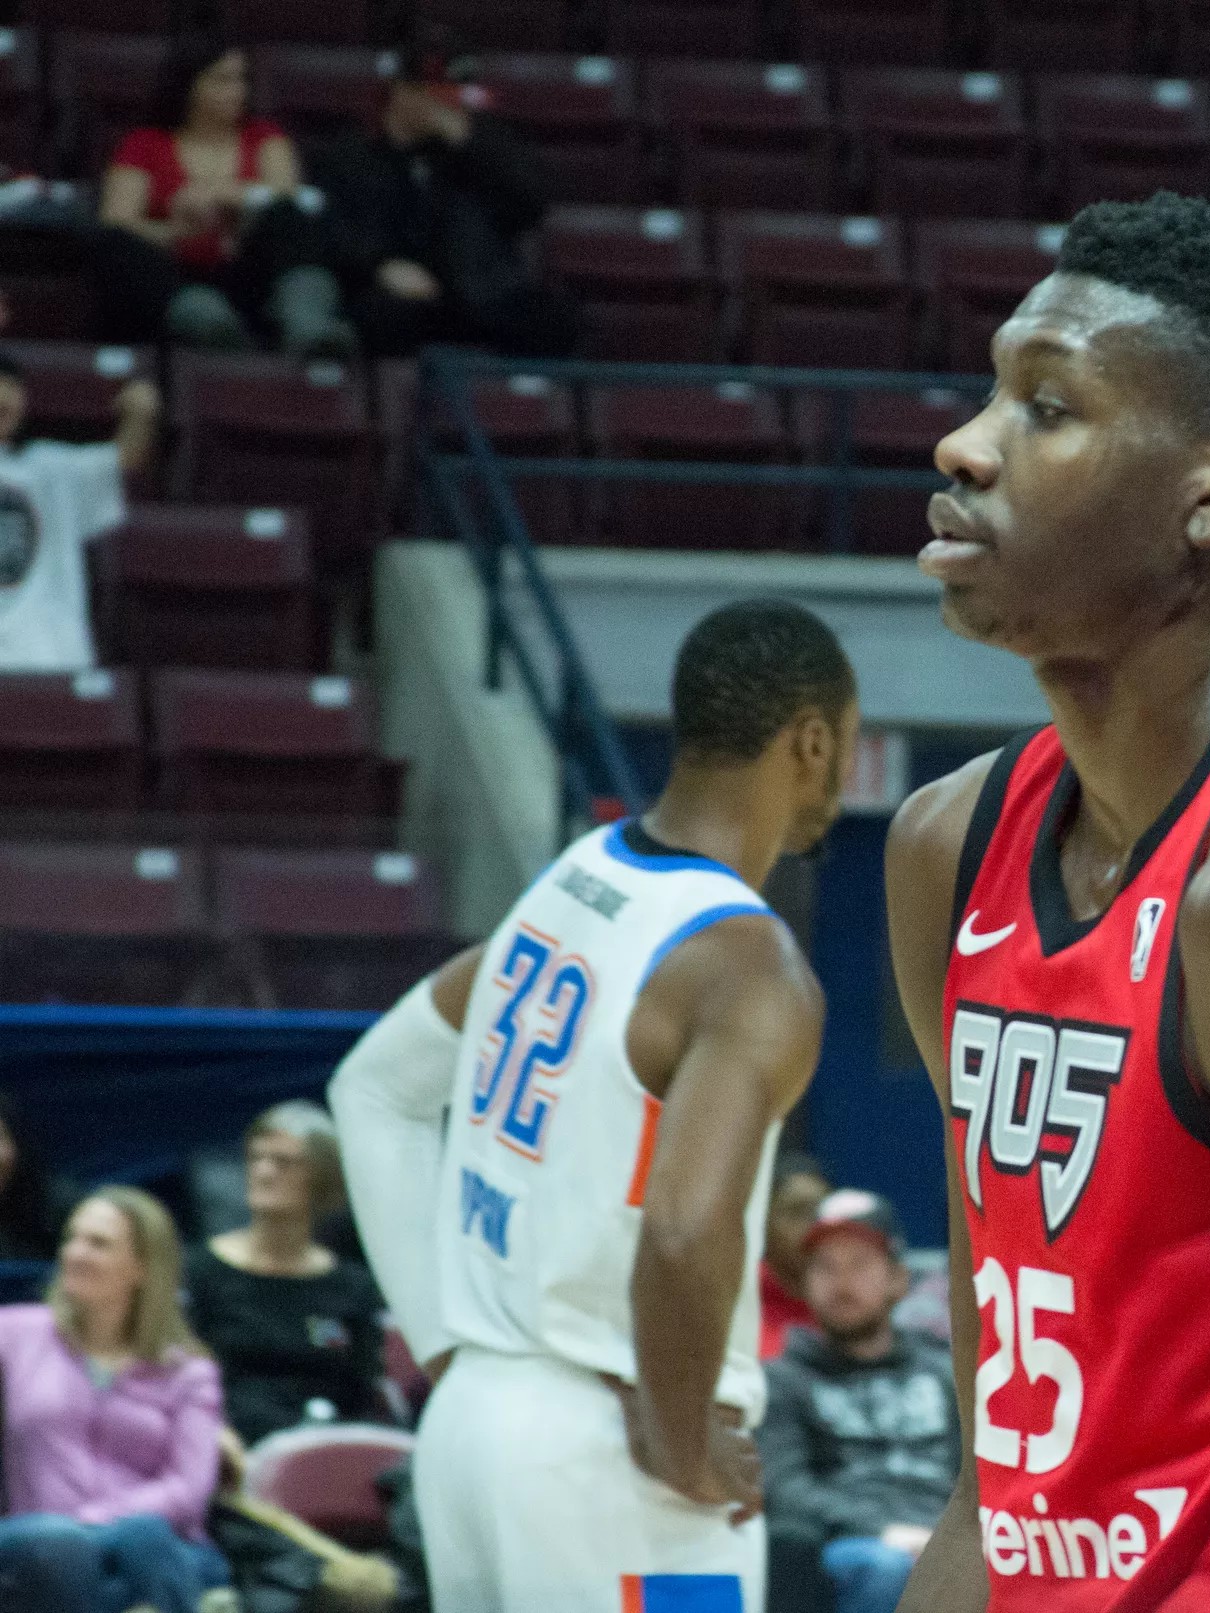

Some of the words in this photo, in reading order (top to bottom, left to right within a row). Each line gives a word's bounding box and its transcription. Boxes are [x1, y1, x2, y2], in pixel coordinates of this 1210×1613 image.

[469, 922, 595, 1163] 32
[949, 1001, 1131, 1243] 905
[973, 1257, 1083, 1474] 25
